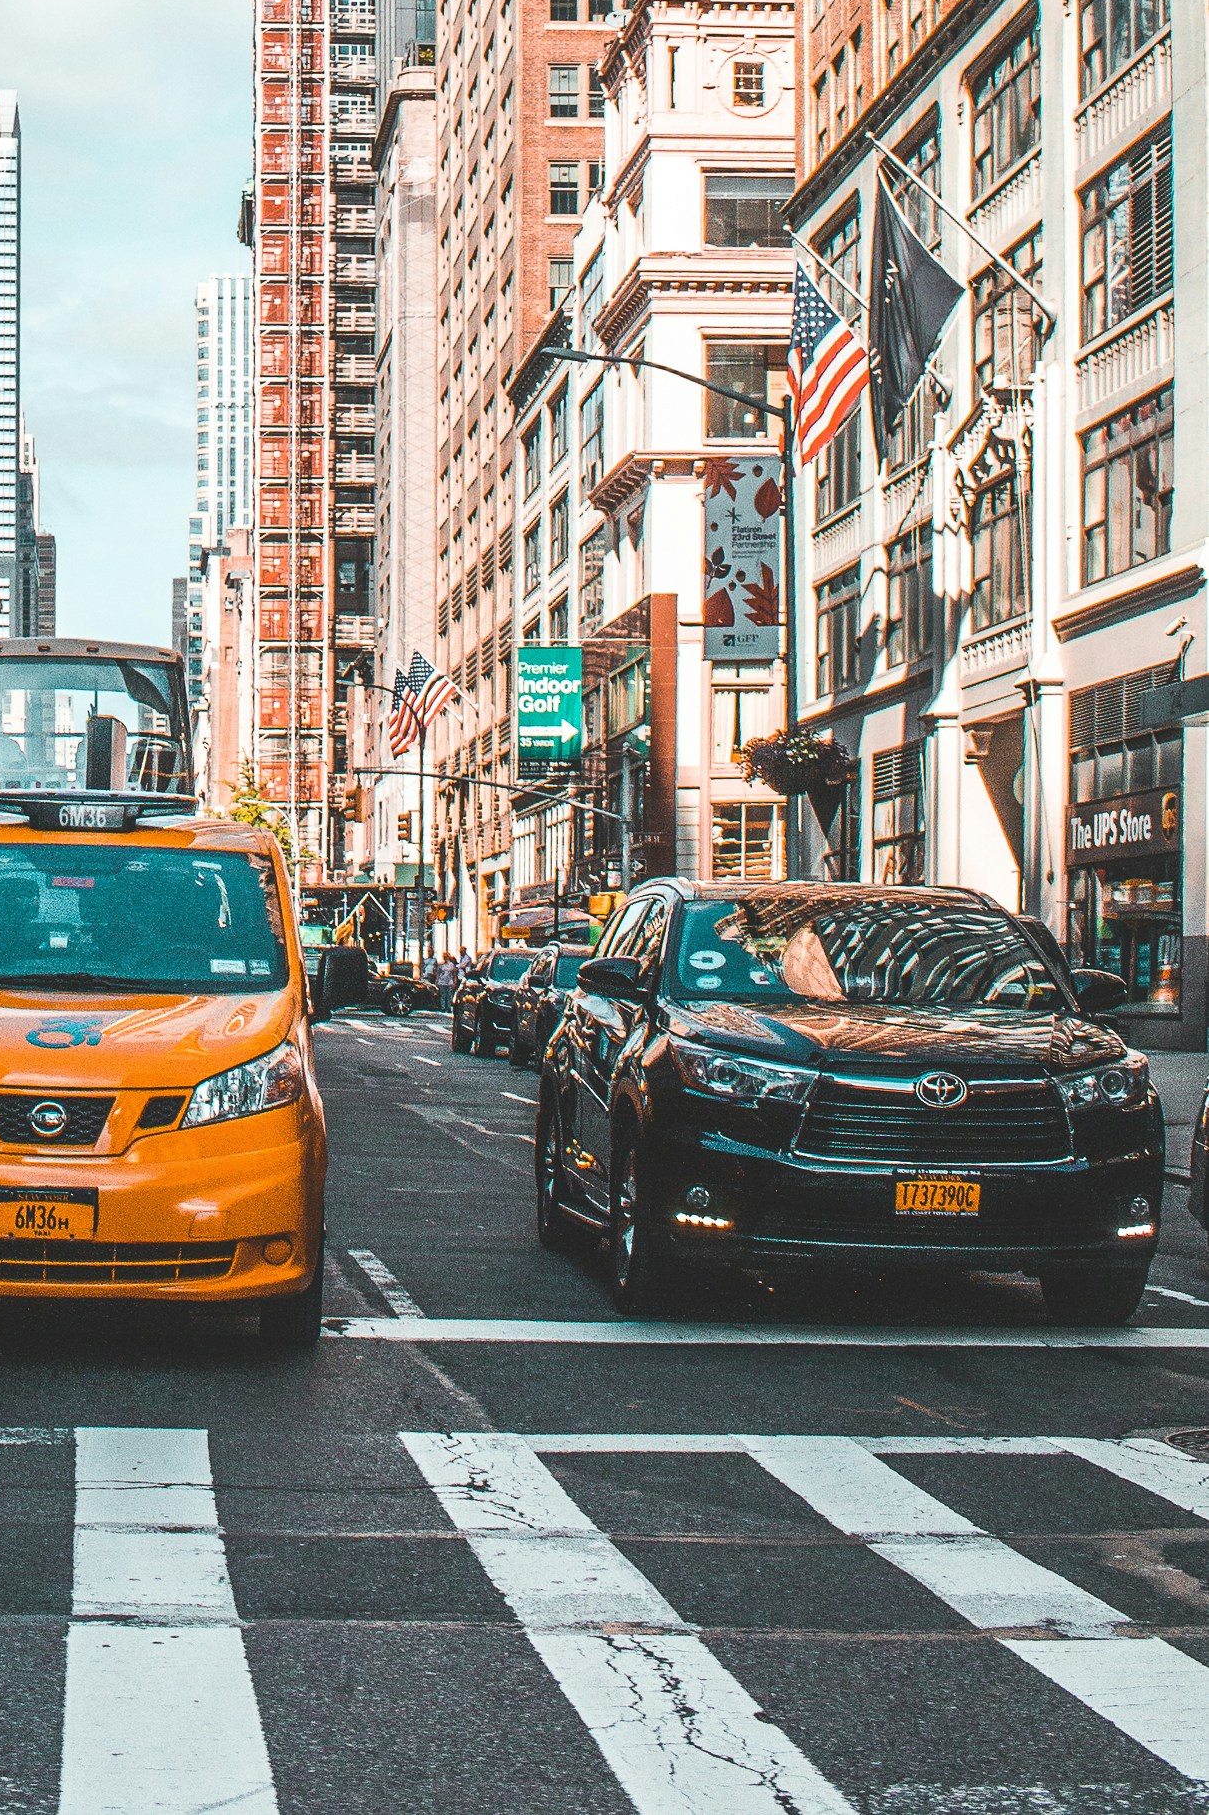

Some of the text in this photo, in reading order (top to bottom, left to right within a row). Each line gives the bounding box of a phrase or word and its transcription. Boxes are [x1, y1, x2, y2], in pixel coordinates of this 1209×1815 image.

[732, 533, 776, 541] 23rd Street
[732, 541, 776, 549] Partnership
[737, 634, 759, 643] GFP
[518, 661, 568, 675] Premier
[518, 676, 581, 694] Indoor
[518, 694, 561, 713] Golf
[519, 737, 532, 747] 35
[58, 805, 107, 827] 6M36
[1070, 816, 1092, 850] The
[1093, 810, 1118, 848] UPS
[1119, 808, 1152, 844] Store
[941, 1174, 962, 1182] YORK
[17, 1193, 69, 1202] NEW YORK
[902, 1184, 975, 1207] T737390C
[15, 1205, 69, 1230] 6M36H
